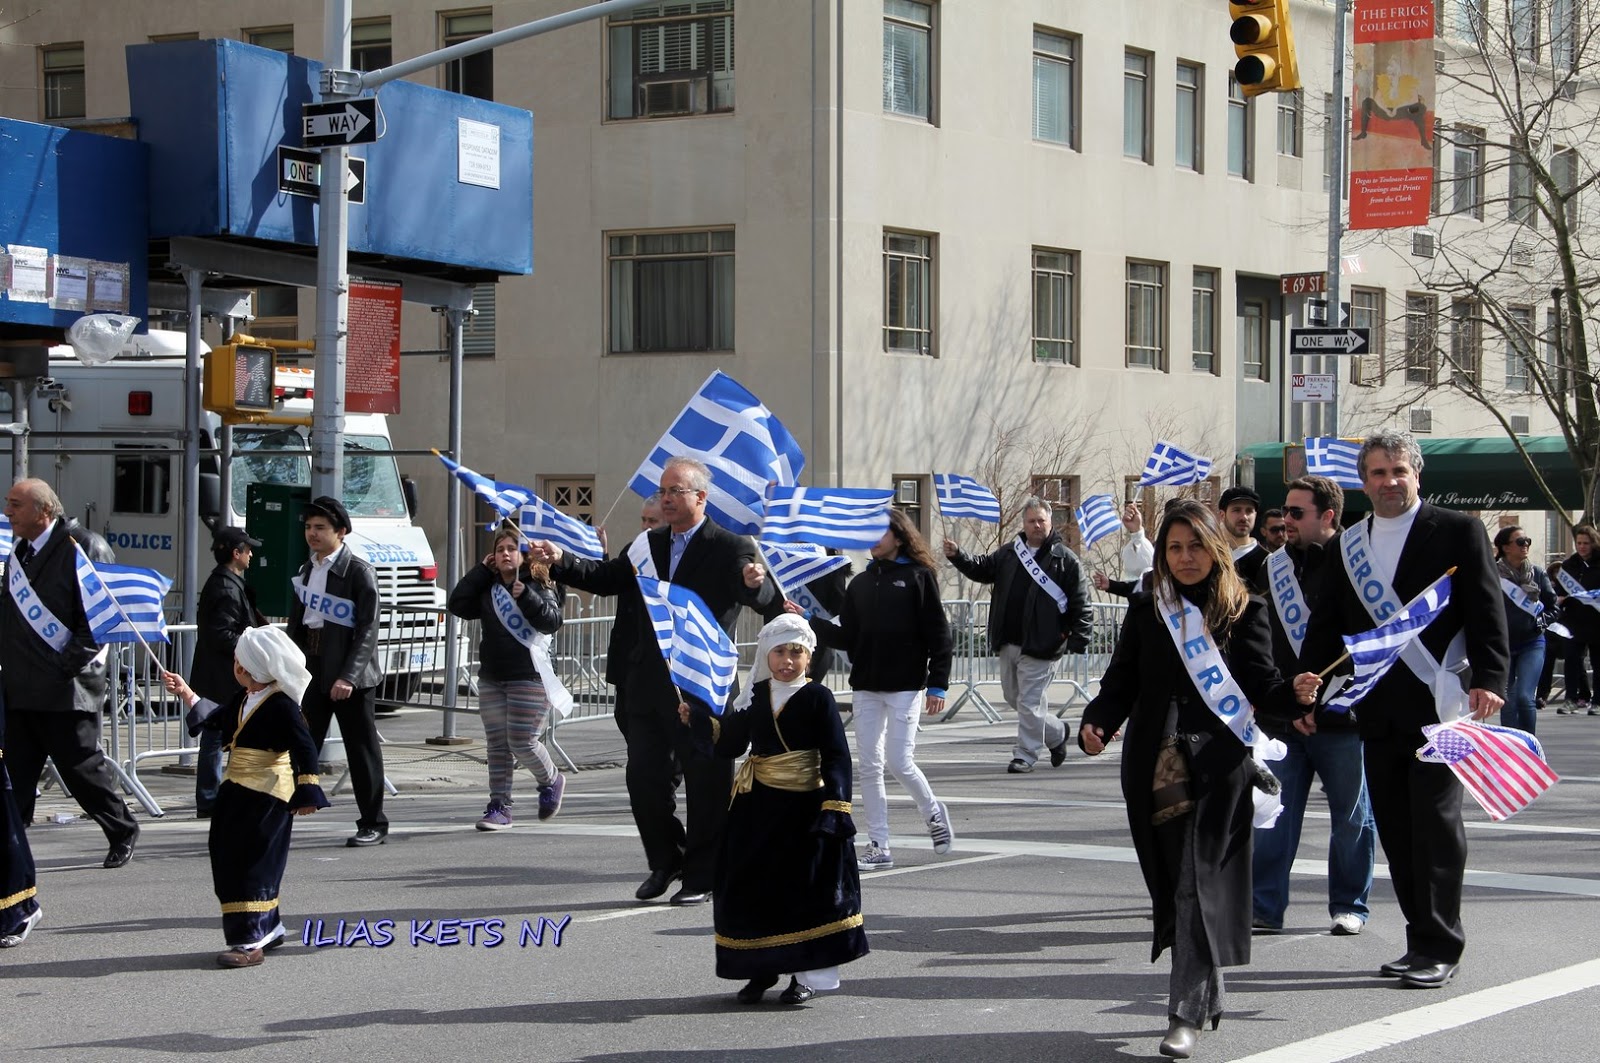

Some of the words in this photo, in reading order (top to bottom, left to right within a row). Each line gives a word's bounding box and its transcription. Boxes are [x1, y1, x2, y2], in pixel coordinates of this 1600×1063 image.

[1361, 9, 1387, 20] THE
[1390, 5, 1428, 18] FRICK
[1360, 19, 1429, 32] COLLECTION
[329, 114, 360, 133] WAY
[290, 162, 314, 182] ONE
[1355, 177, 1372, 186] Degas
[1361, 186, 1389, 194] Drawings
[1369, 196, 1384, 205] from
[1282, 278, 1288, 294] E
[1293, 276, 1305, 293] 69
[1309, 275, 1321, 292] ST
[1301, 336, 1324, 347] ONE
[1333, 336, 1358, 347] WAY
[1292, 376, 1305, 386] NO
[1444, 491, 1496, 509] Seventy
[1499, 491, 1529, 504] Five
[106, 532, 172, 550] POLICE
[366, 550, 418, 563] POLICE
[1015, 542, 1049, 585] LEROS
[1346, 536, 1396, 621] LEROS
[1560, 572, 1582, 594] EROS
[11, 568, 60, 638] EROS
[1272, 564, 1308, 641] LEROS
[1509, 587, 1543, 616] LER
[1169, 606, 1255, 743] LEROS
